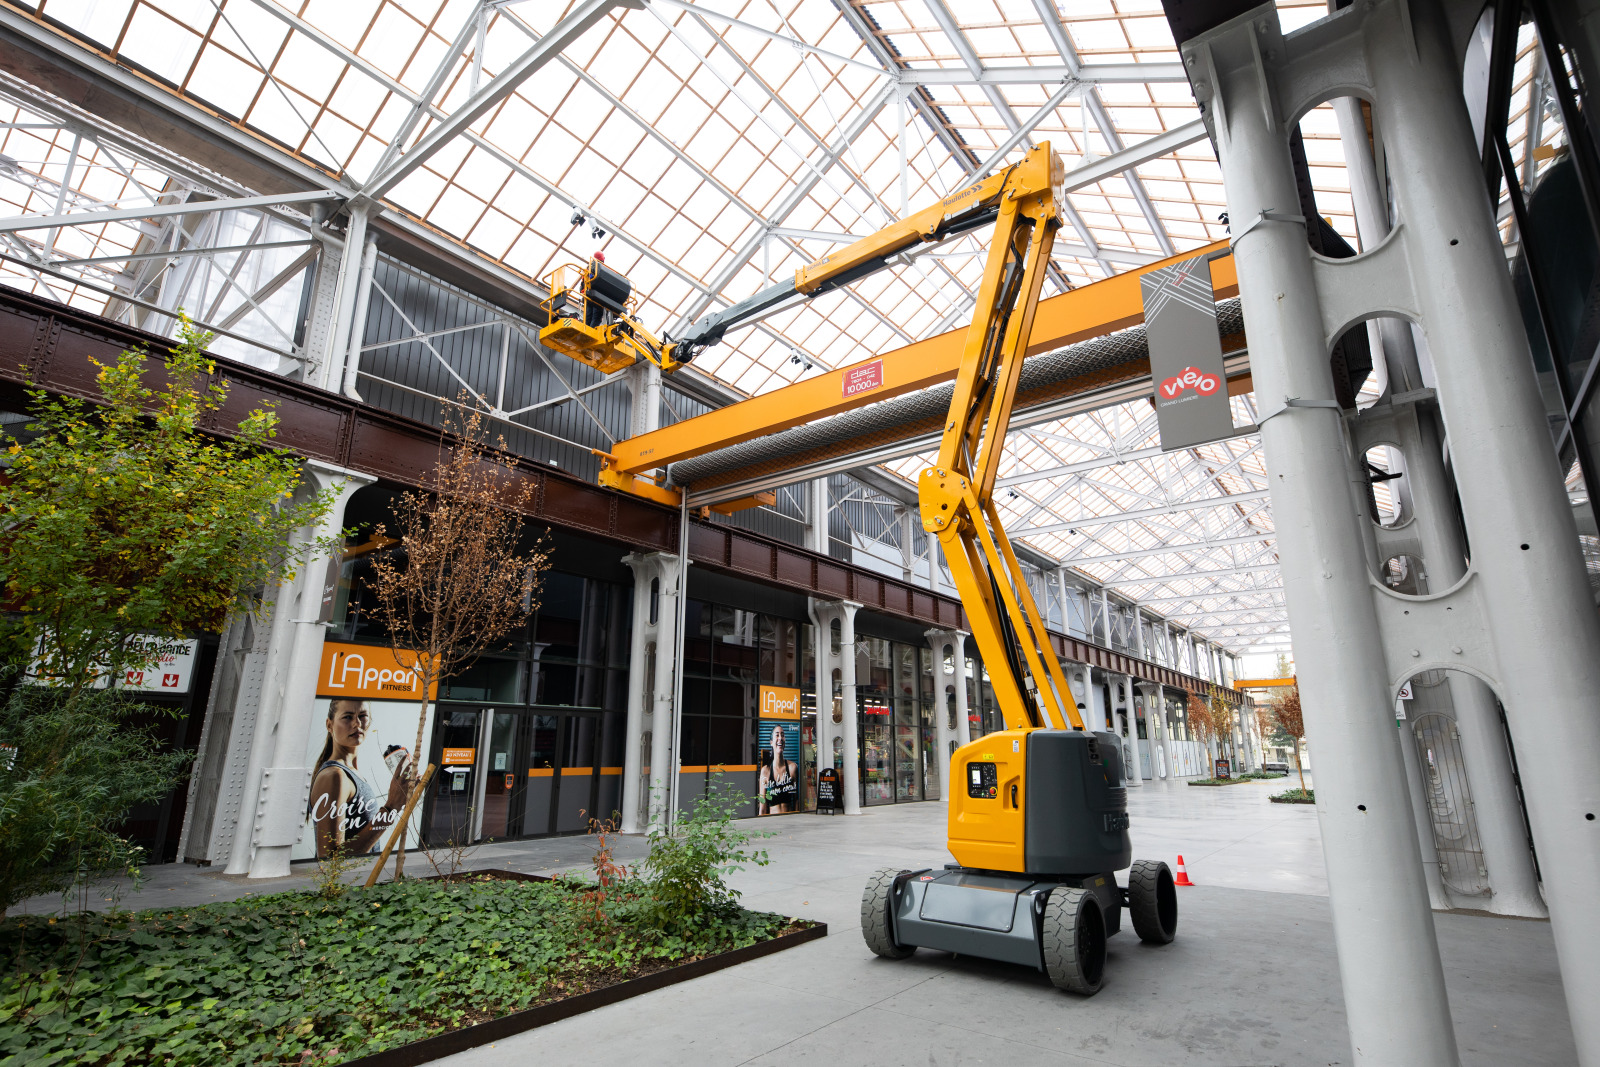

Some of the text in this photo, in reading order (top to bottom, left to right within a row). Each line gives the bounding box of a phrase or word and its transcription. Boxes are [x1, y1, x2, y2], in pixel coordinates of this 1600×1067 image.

[943, 190, 971, 207] Haulotte
[328, 652, 423, 692] L'Appart
[381, 684, 412, 692] FITNESS
[763, 691, 799, 715] L'Appart
[312, 792, 376, 822] Croire
[338, 816, 367, 832] en
